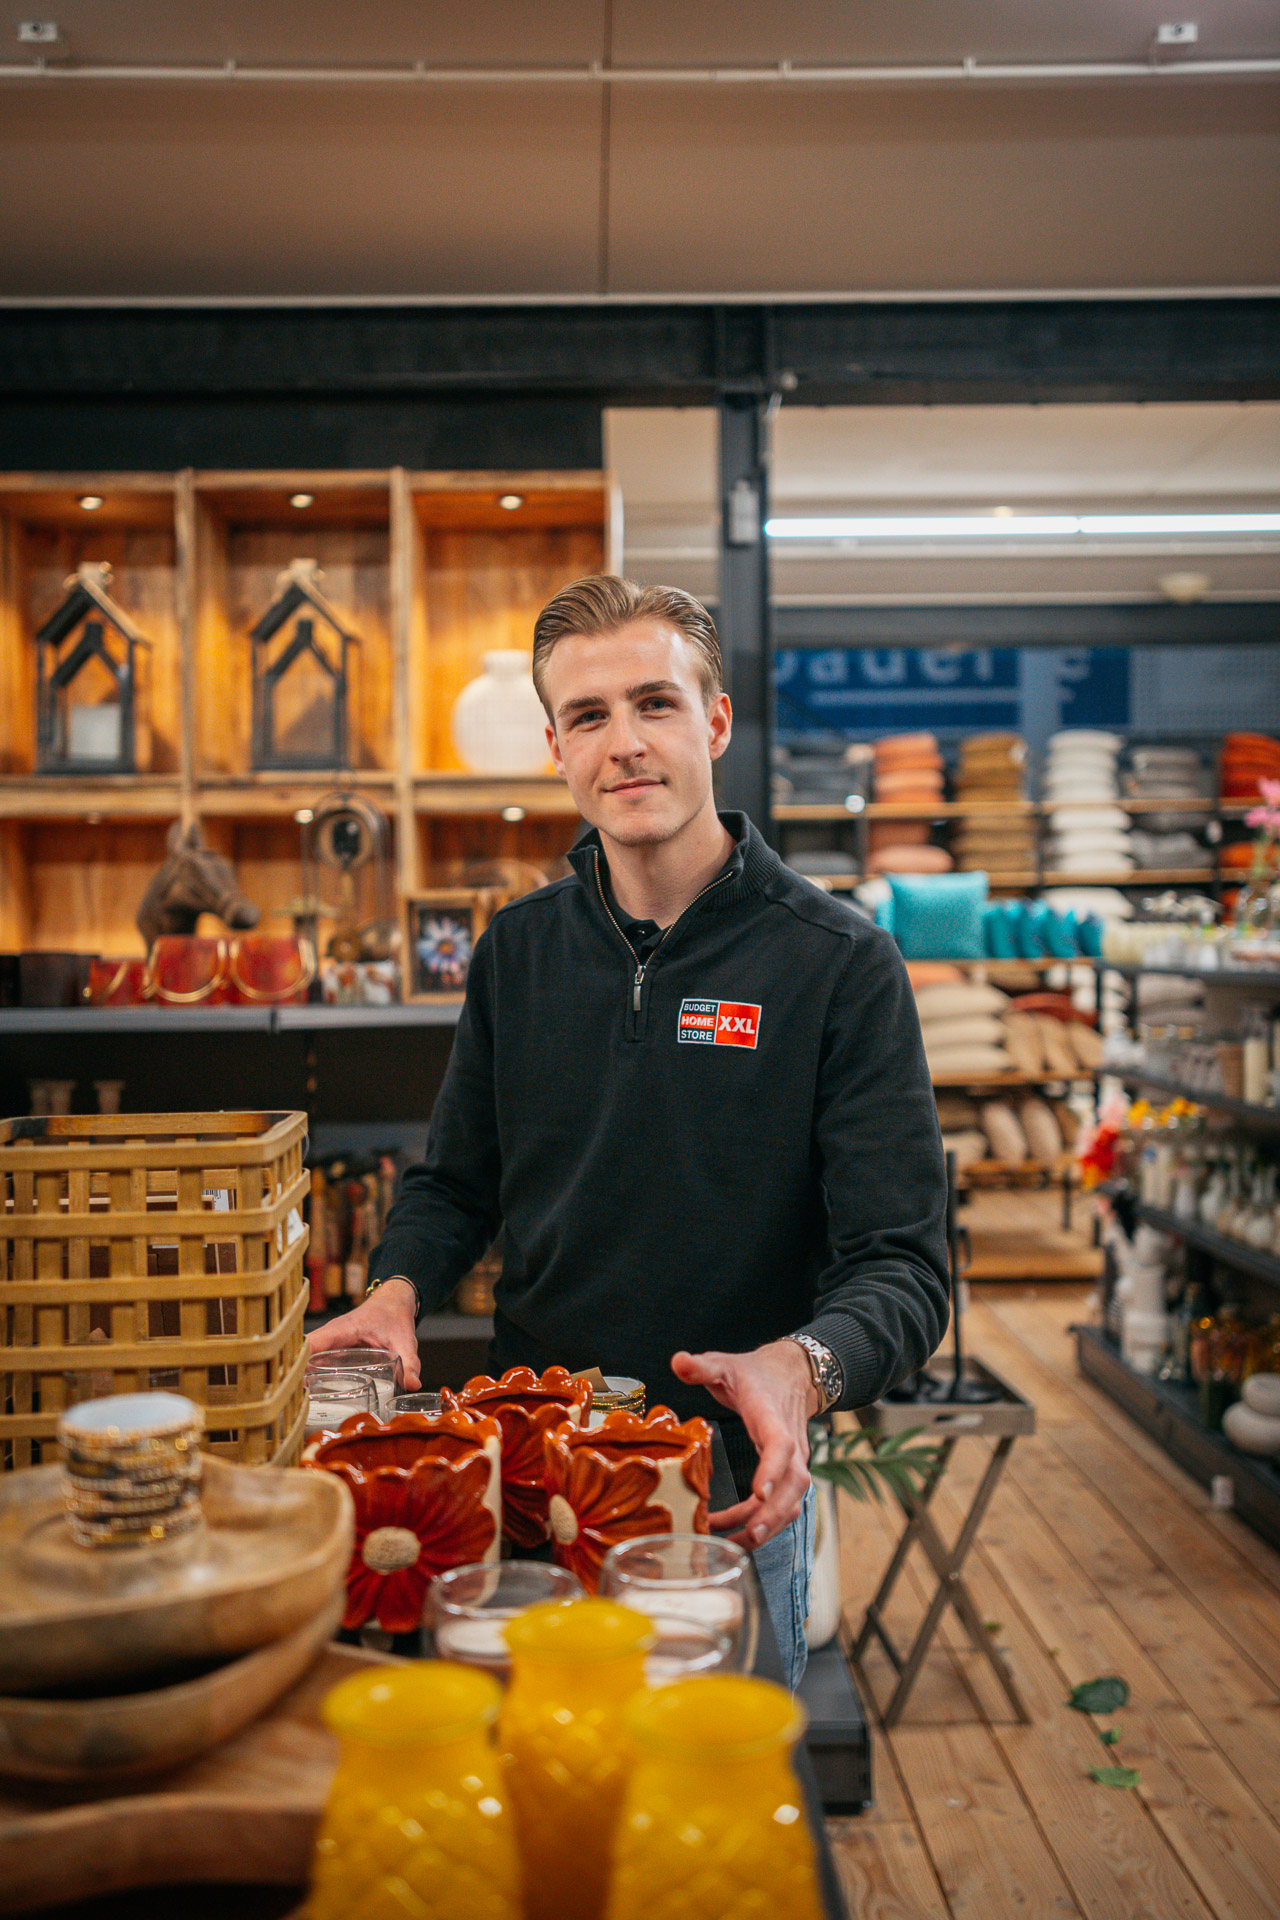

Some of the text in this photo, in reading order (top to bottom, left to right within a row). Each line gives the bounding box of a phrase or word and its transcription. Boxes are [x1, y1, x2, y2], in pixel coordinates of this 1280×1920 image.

[683, 1003, 716, 1013] BUDGET
[681, 1015, 714, 1027] HOME
[718, 1015, 755, 1034] XXL
[681, 1030, 713, 1041] STORE
